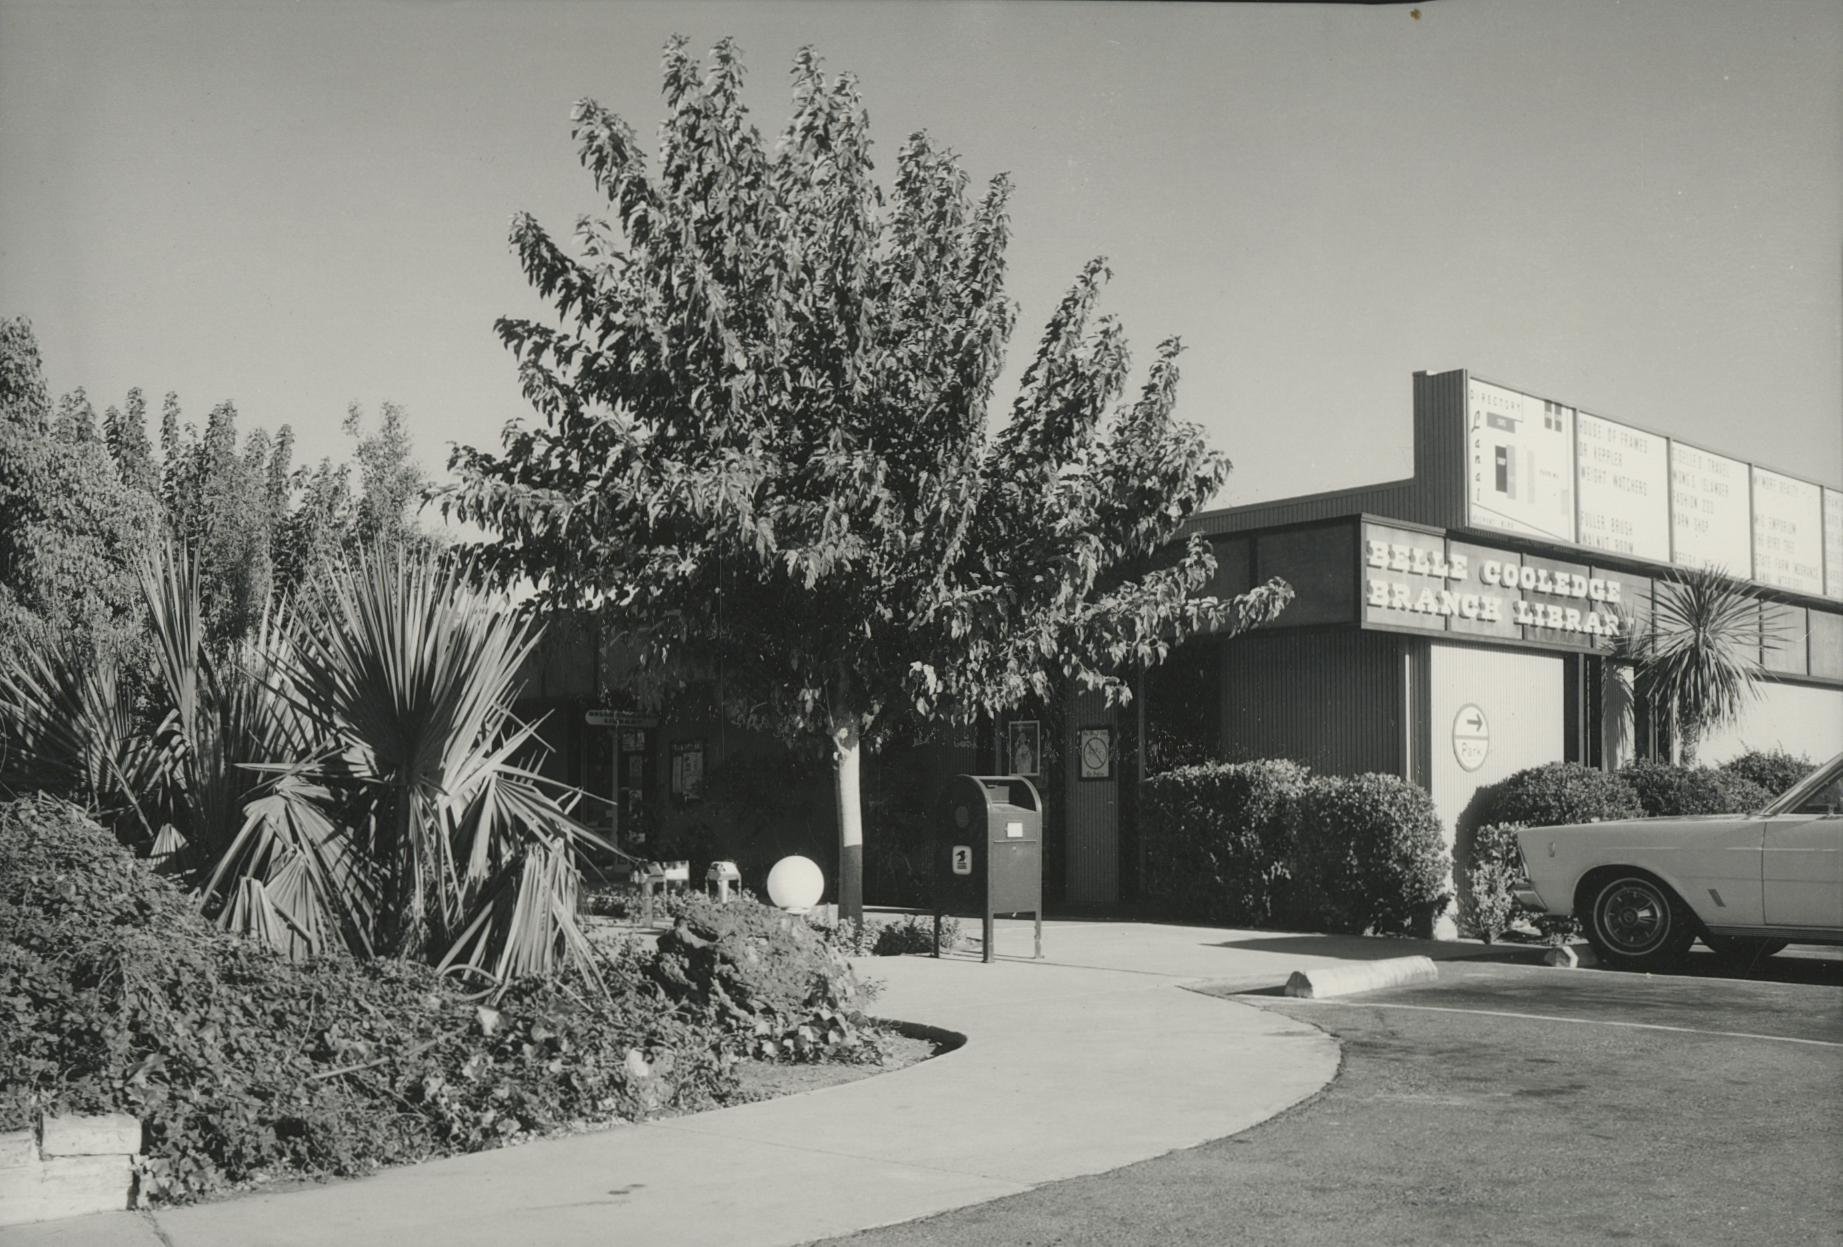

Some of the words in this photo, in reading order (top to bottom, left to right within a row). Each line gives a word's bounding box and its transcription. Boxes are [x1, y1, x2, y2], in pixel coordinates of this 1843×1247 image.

[1470, 388, 1521, 413] DIRECTORY
[1579, 419, 1602, 440] HOUSE
[1608, 427, 1616, 443] OF
[1620, 431, 1648, 454] FRAMES
[1593, 446, 1623, 467] KEPPLER
[1707, 458, 1730, 478] TRAVEL
[1580, 464, 1607, 486] WEIGHT
[1613, 474, 1648, 497] WATCHERS
[1580, 510, 1605, 530] FULLER
[1611, 517, 1634, 537] BRUSH
[1615, 538, 1634, 556] ROOM
[1367, 540, 1468, 581] BELLE
[1480, 560, 1621, 604] COOLEDGE
[1367, 580, 1503, 622] BRANCH
[1513, 600, 1634, 637] LIBRAR
